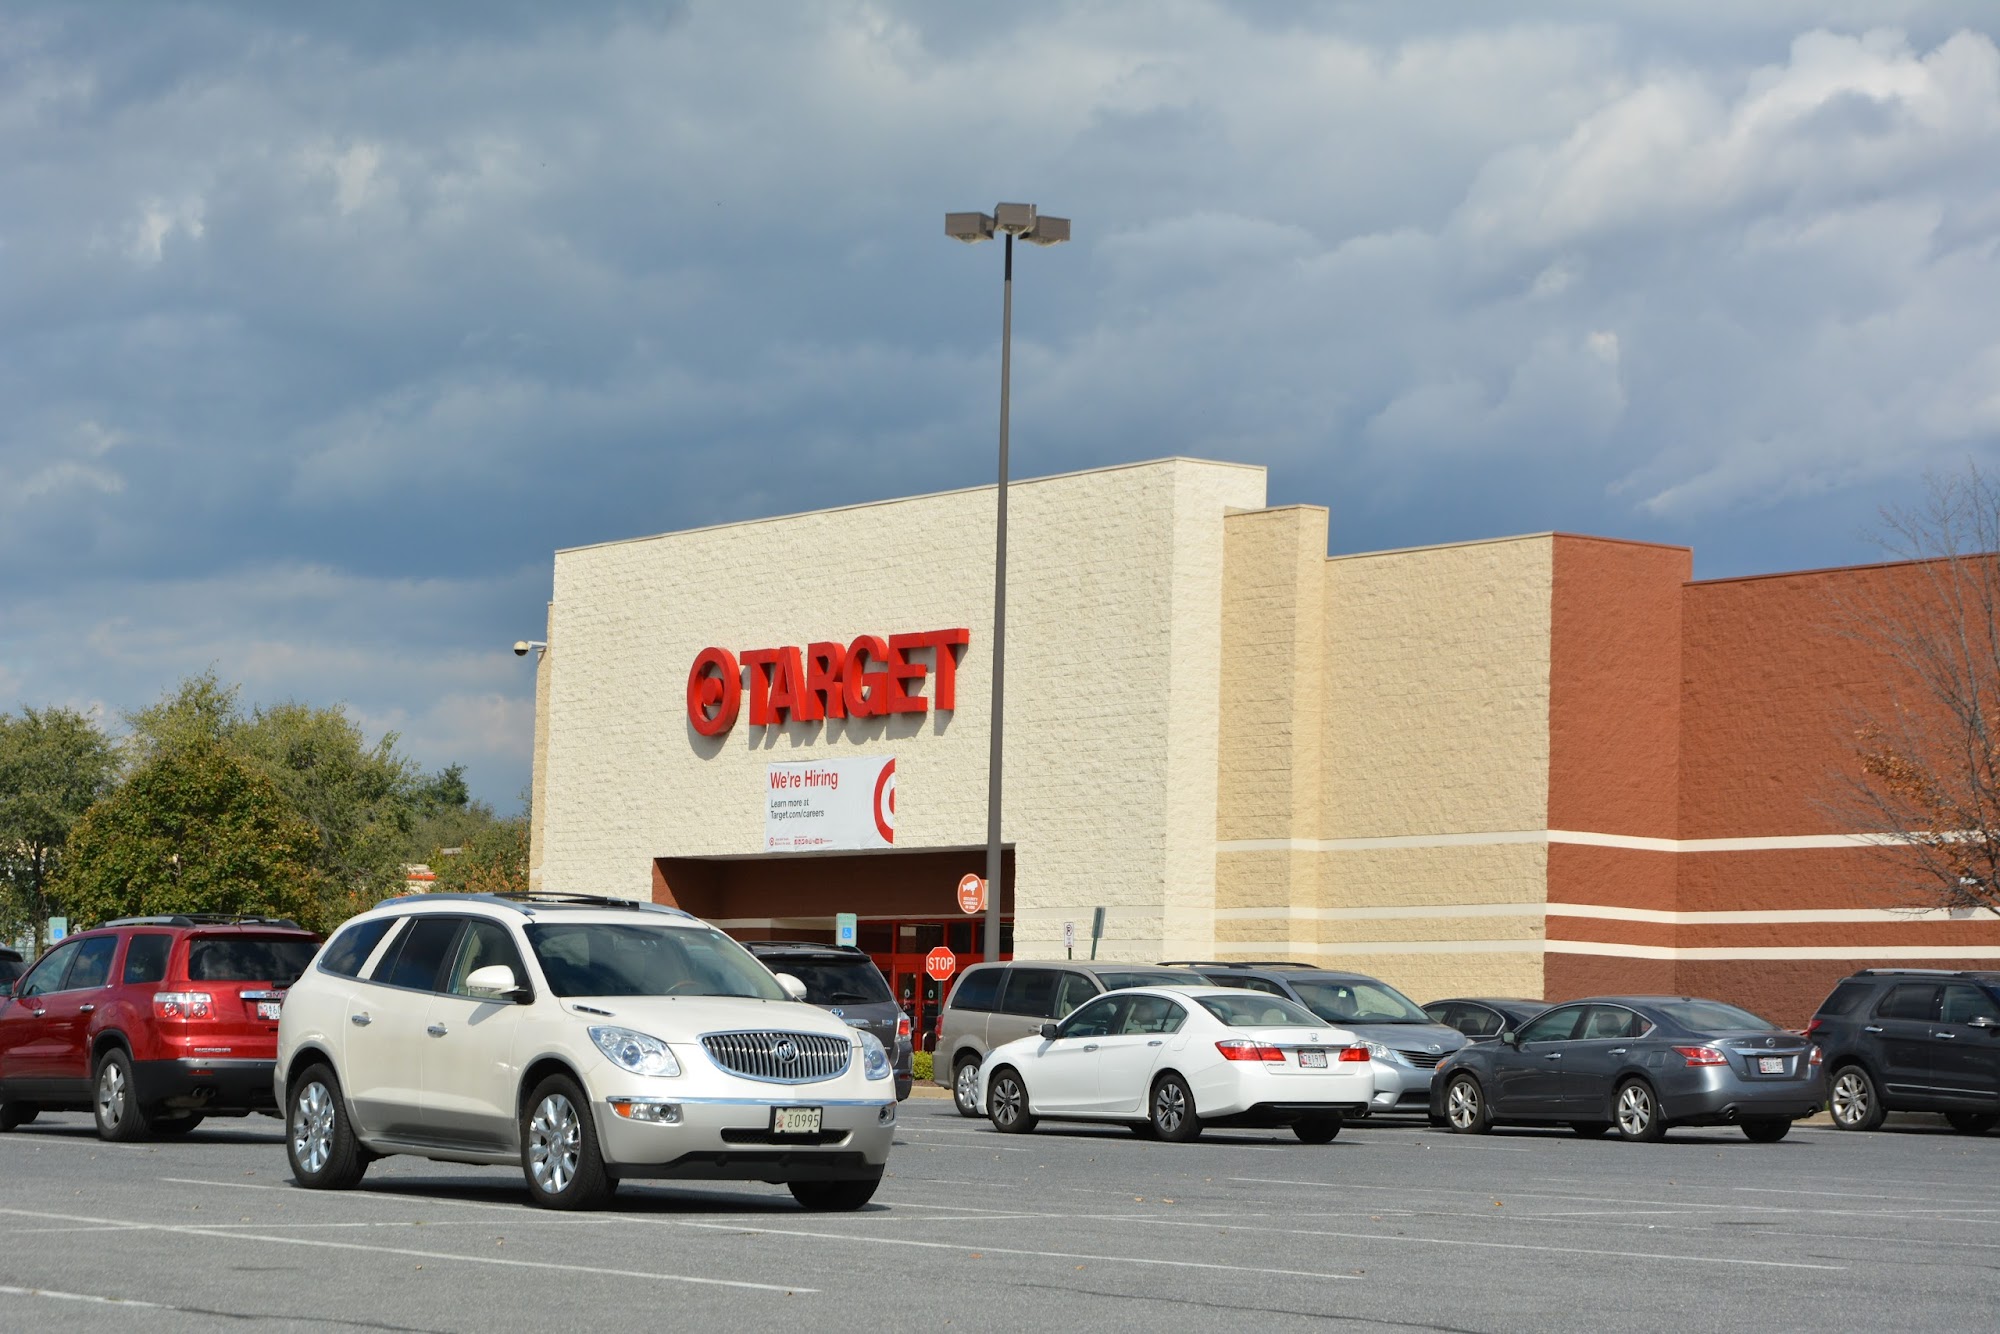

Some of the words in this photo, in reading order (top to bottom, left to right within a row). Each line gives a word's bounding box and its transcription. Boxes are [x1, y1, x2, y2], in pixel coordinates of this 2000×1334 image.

[740, 628, 970, 726] TARGET
[770, 771, 801, 789] We're
[804, 769, 838, 790] Hiring
[770, 800, 786, 808] Learn
[803, 798, 809, 807] at
[770, 809, 824, 821] Target.com/careers
[928, 956, 954, 971] STOP
